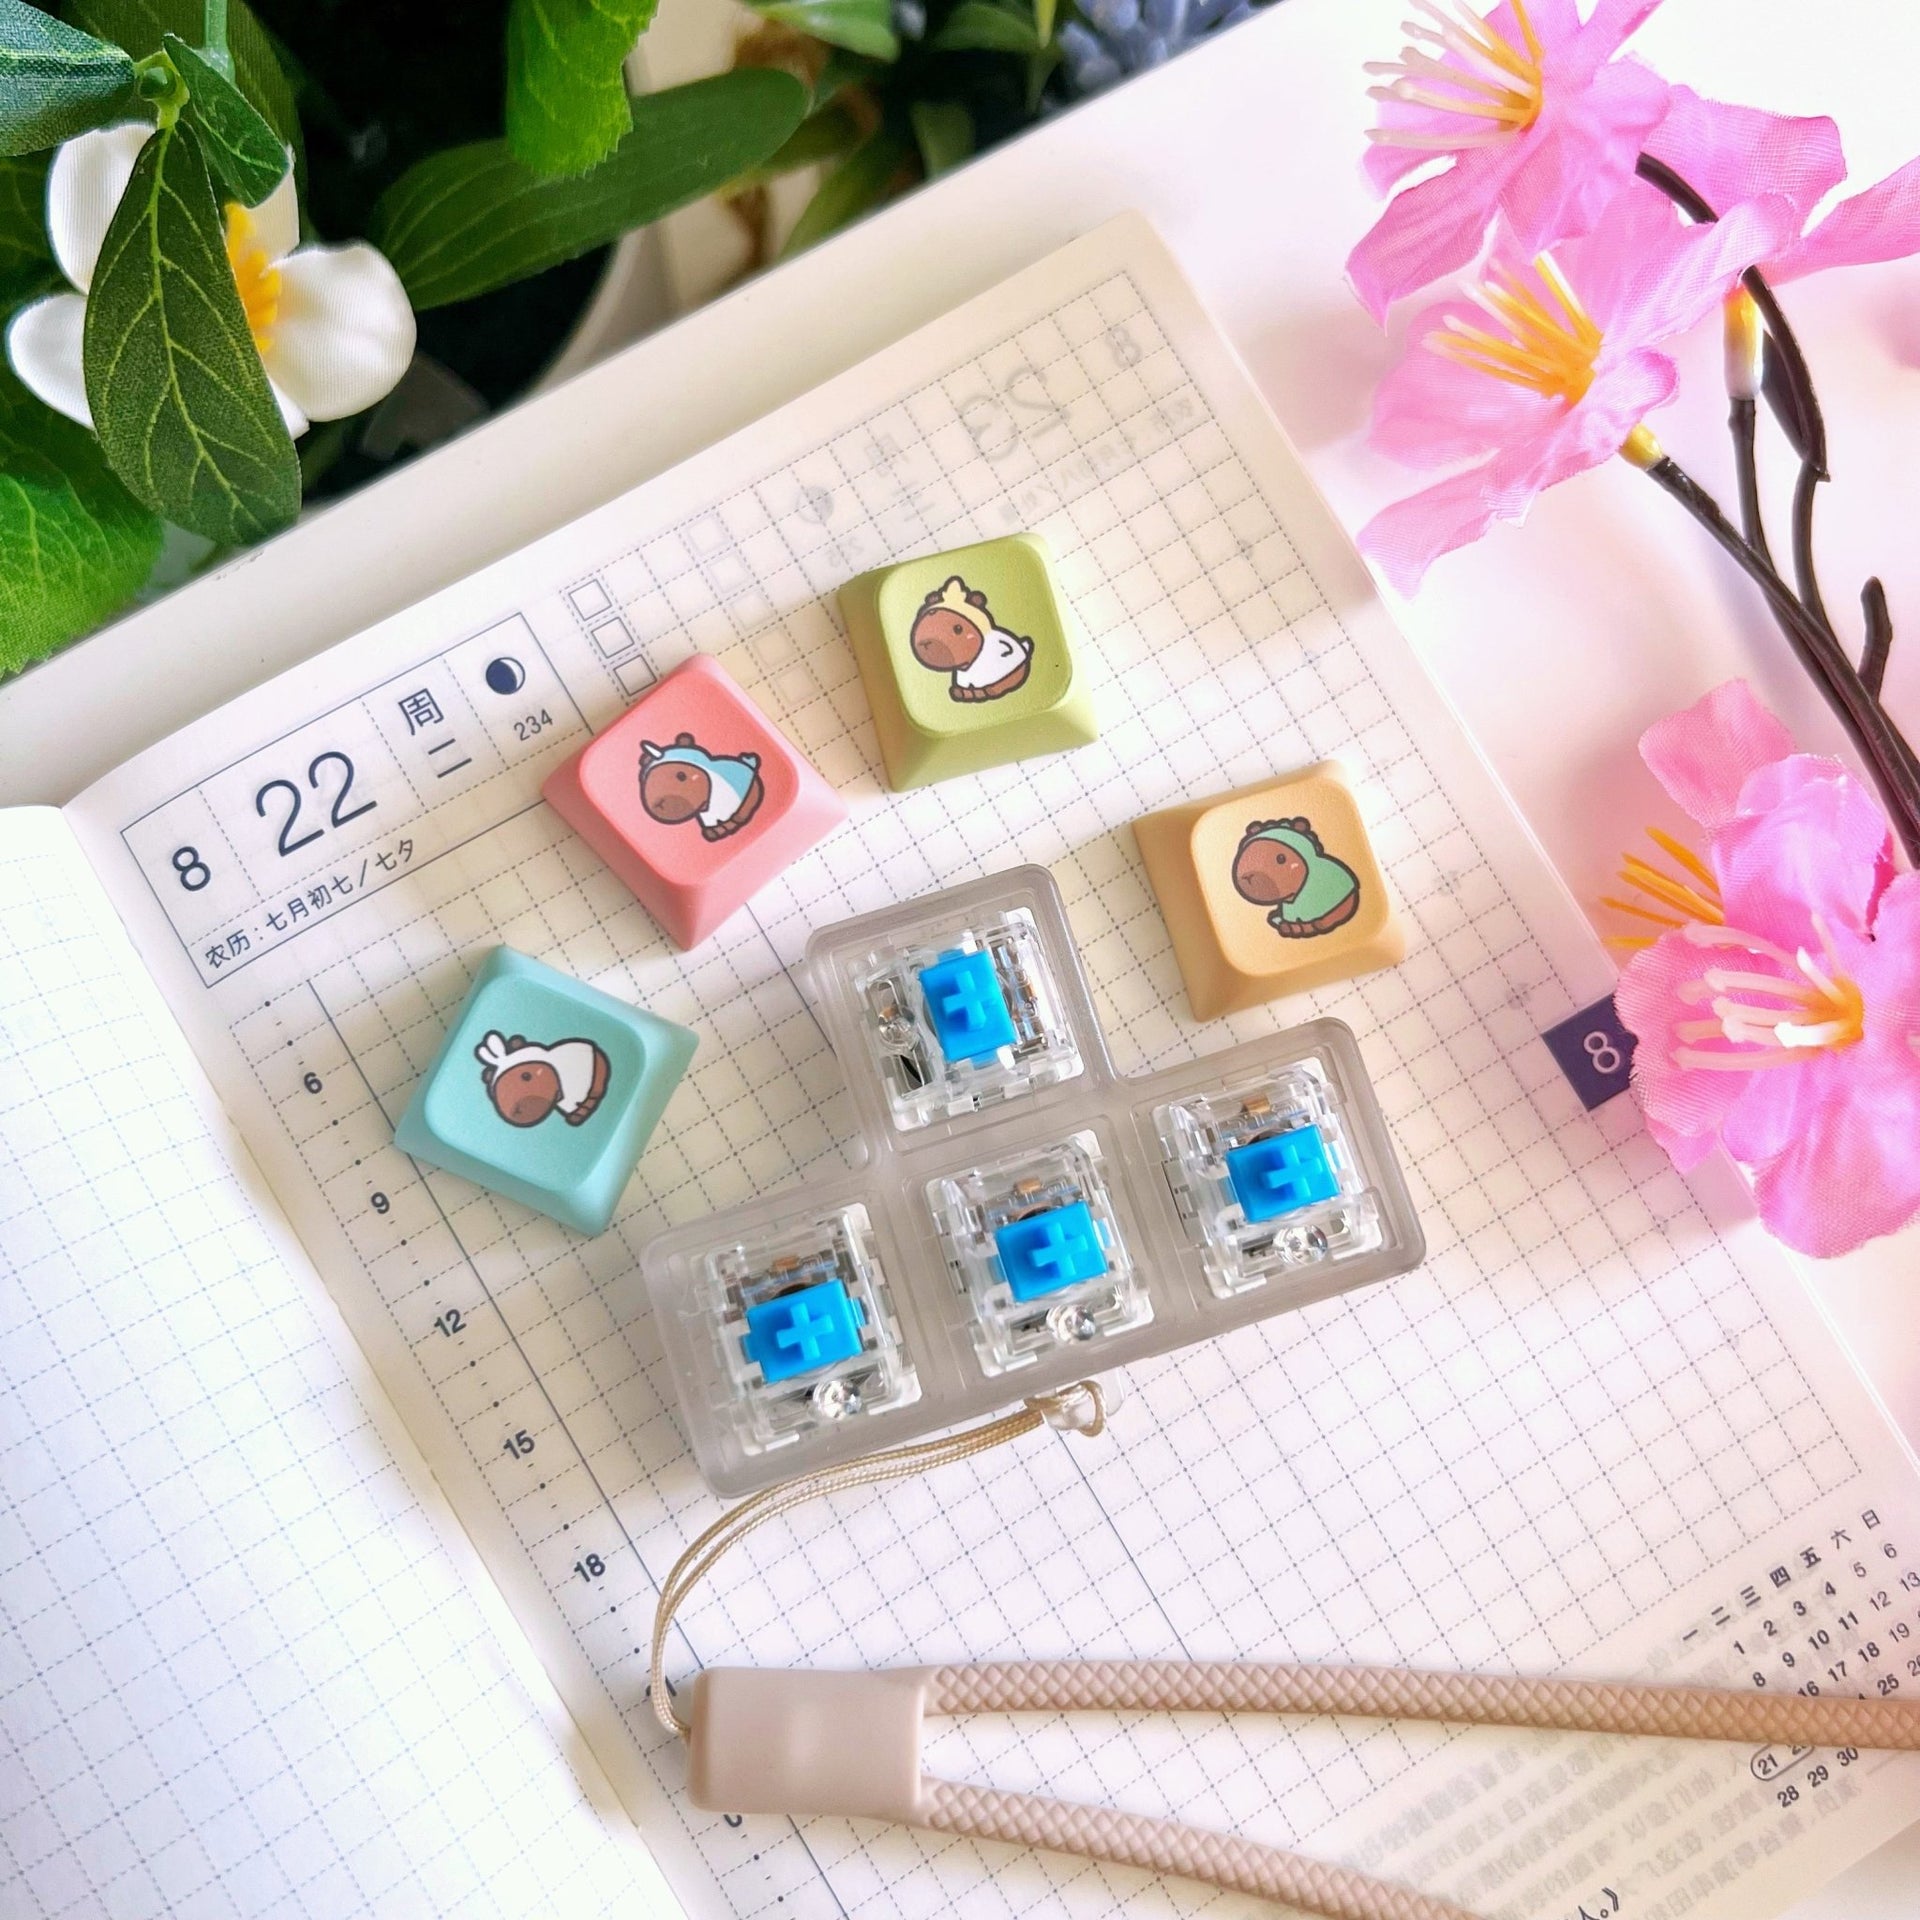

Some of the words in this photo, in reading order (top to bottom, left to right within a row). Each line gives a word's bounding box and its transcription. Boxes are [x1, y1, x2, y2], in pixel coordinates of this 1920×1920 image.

[514, 708, 553, 741] 234
[255, 750, 378, 858] 22
[171, 846, 212, 892] 8
[1583, 1030, 1621, 1074] 8
[303, 1071, 323, 1095] 6
[370, 1191, 390, 1215] 9
[433, 1308, 467, 1338] 12
[502, 1429, 535, 1460] 15
[573, 1553, 606, 1583] 18
[1711, 1605, 1731, 1626] 二
[1740, 1585, 1762, 1608] 三
[1769, 1565, 1792, 1589] 四
[1799, 1546, 1822, 1569] 五
[1830, 1529, 1852, 1550] 六
[1861, 1509, 1881, 1530] 日
[1733, 1640, 1745, 1655] 1
[1763, 1619, 1778, 1637] 2
[1792, 1600, 1807, 1616] 3
[1825, 1581, 1837, 1596] 4
[1853, 1561, 1867, 1578] 5
[1883, 1542, 1898, 1559] 6
[1752, 1671, 1766, 1688] 8
[1781, 1651, 1796, 1668] 9
[1808, 1629, 1830, 1650] 10
[1837, 1610, 1859, 1631] 11
[1869, 1590, 1892, 1612] 12
[1899, 1571, 1920, 1592] 13
[1827, 1660, 1848, 1682] 17
[1857, 1641, 1881, 1663] 18
[1888, 1622, 1911, 1644] 19
[1876, 1673, 1900, 1696] 25
[1906, 1655, 1920, 1677] 2
[1757, 1753, 1779, 1776] 21
[1777, 1784, 1800, 1808] 28
[1807, 1764, 1829, 1788] 29
[1836, 1746, 1860, 1767] 30
